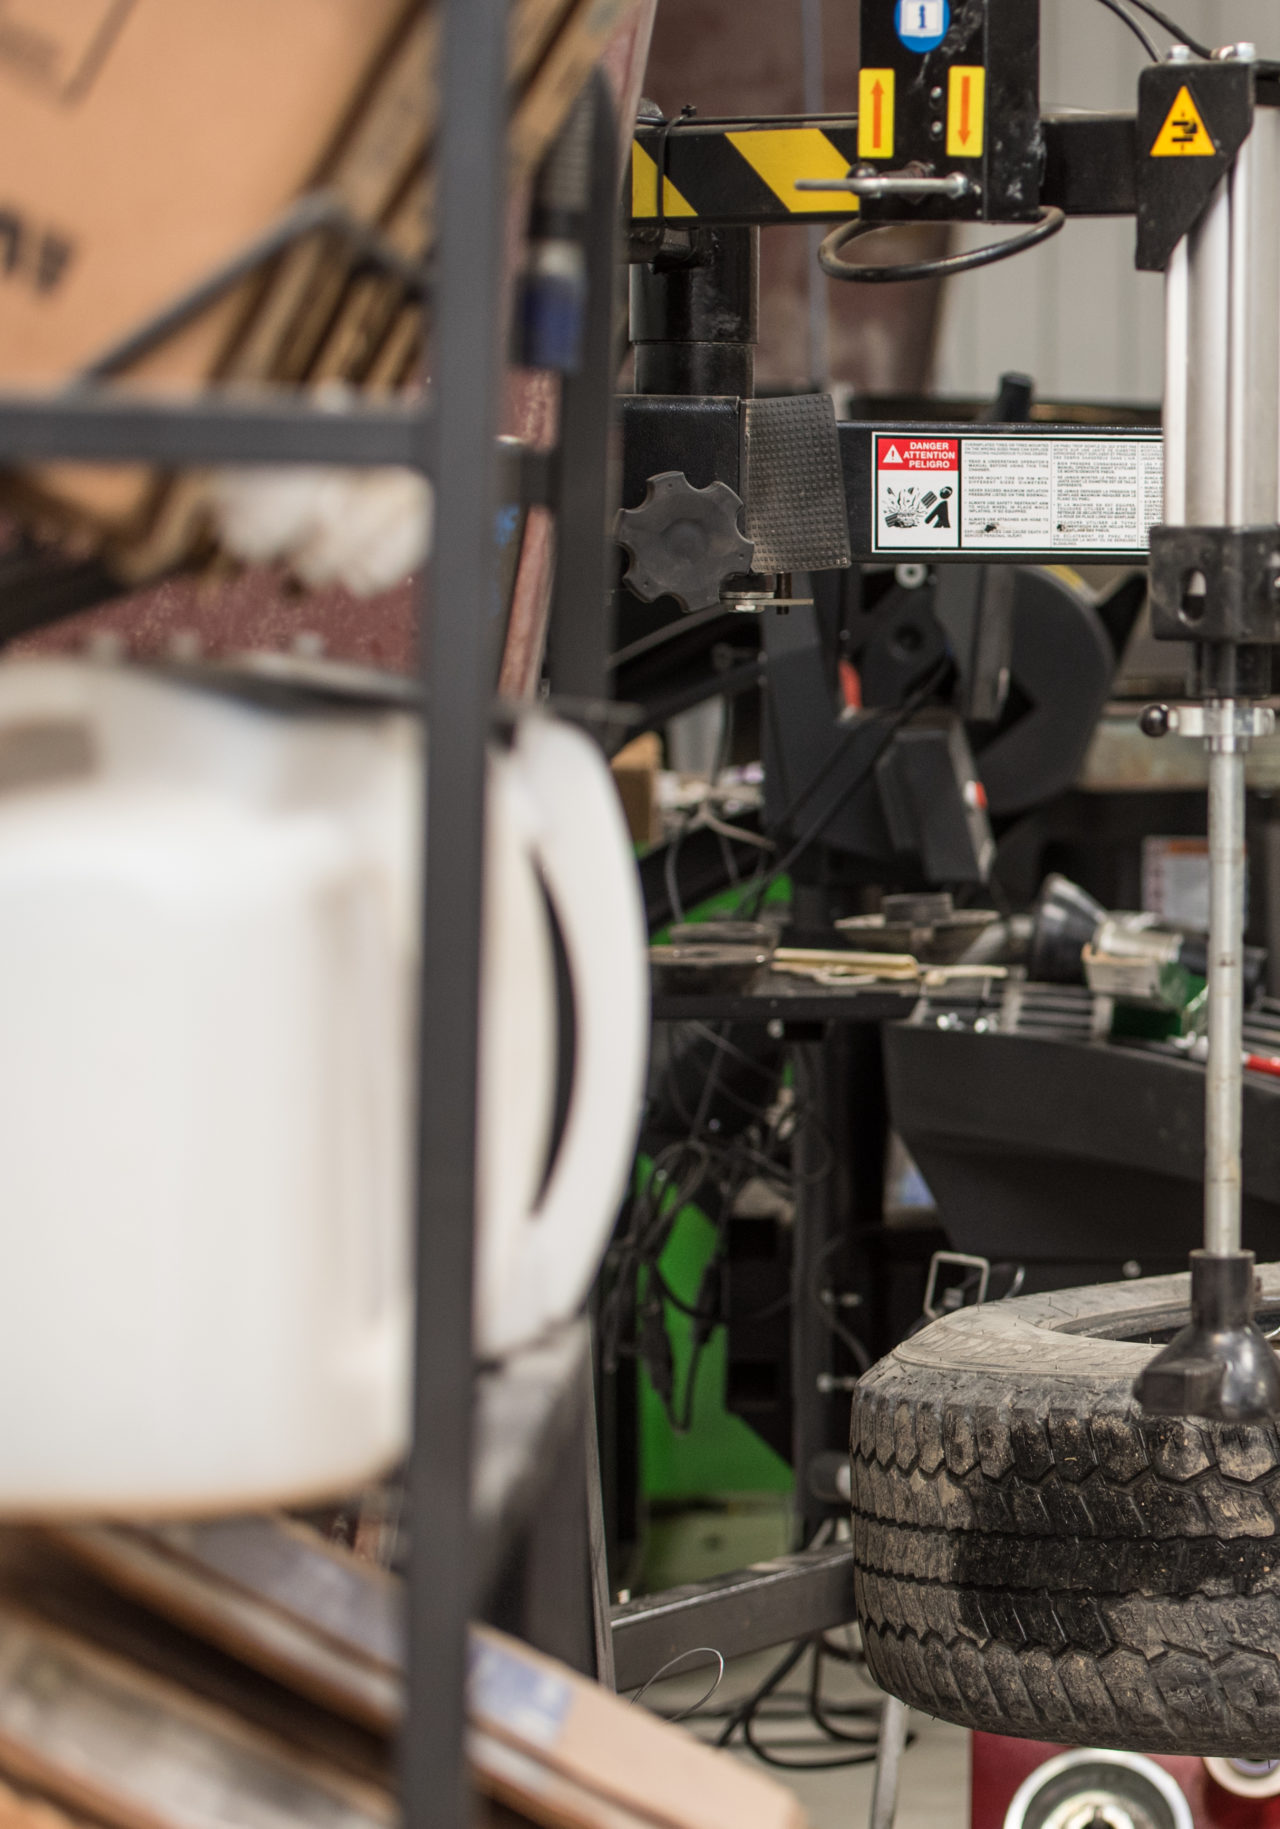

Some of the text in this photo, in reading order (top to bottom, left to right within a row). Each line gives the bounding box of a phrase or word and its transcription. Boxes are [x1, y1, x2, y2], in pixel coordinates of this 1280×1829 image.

[910, 442, 948, 450] DANGER
[903, 451, 955, 460] ATTENTION
[908, 460, 950, 468] PELIGRO
